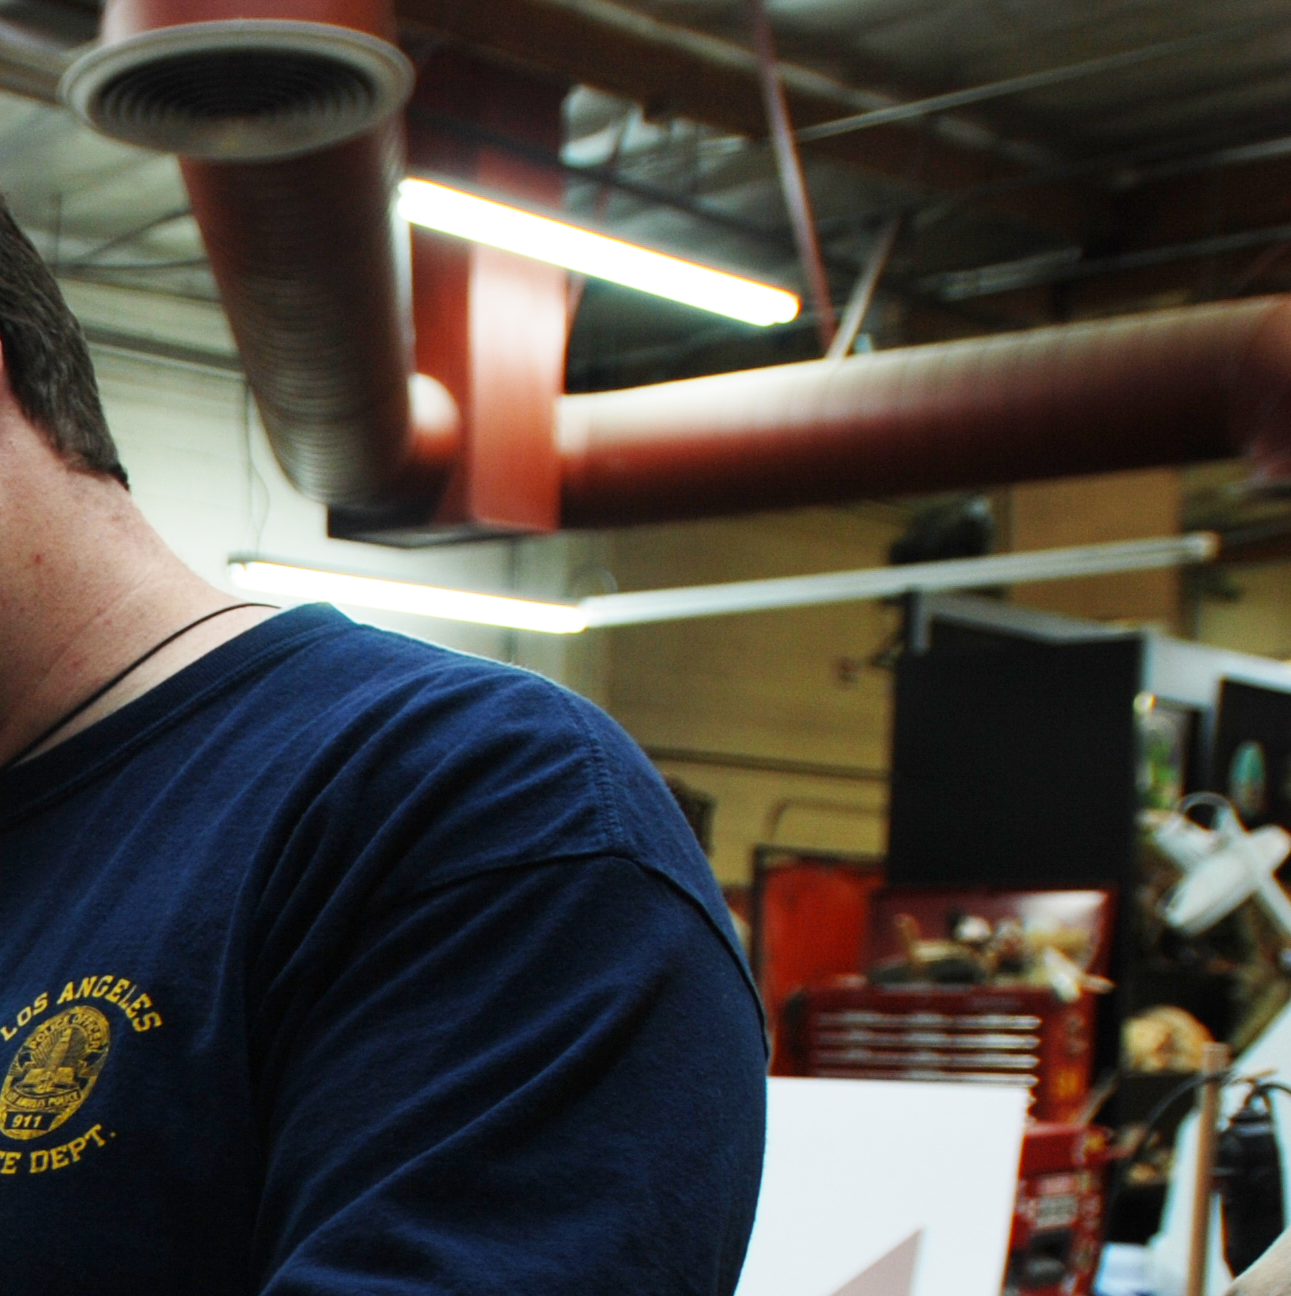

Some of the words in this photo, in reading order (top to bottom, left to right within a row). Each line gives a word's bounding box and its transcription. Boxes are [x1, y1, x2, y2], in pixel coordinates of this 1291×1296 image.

[0, 991, 49, 1041] LOS
[56, 974, 162, 1033] ANGELES
[11, 1113, 42, 1128] 911
[29, 1123, 117, 1174] DEPT.
